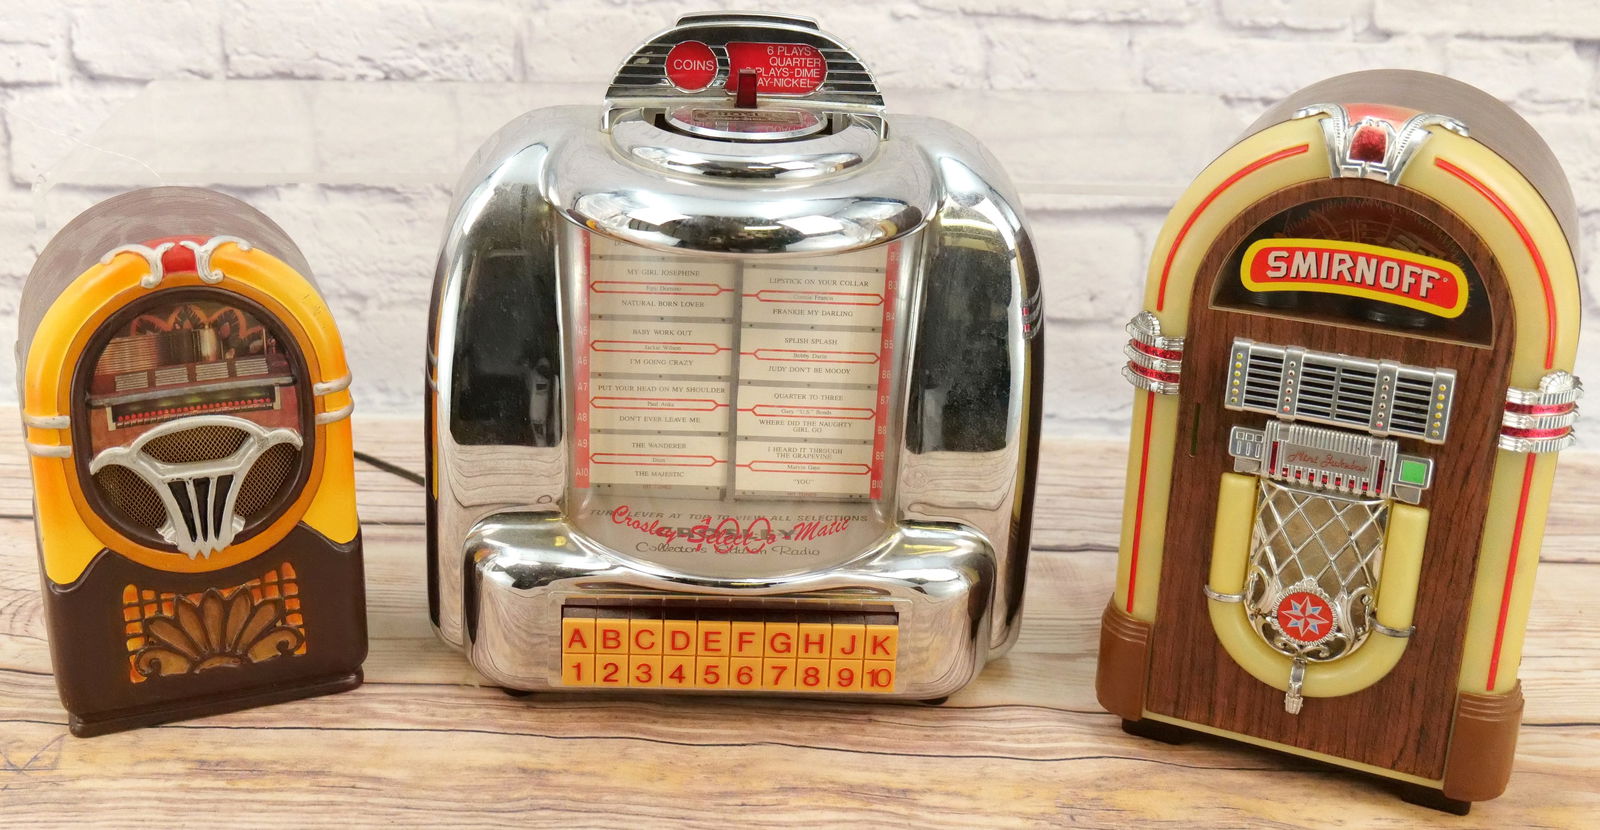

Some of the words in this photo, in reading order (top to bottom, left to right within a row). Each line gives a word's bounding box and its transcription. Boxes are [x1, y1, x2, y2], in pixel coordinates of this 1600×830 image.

[766, 46, 774, 57] 6
[673, 58, 714, 72] COINS
[769, 56, 821, 68] QUARTER
[756, 78, 814, 88] AY-NICKEL
[627, 268, 638, 276] MY
[661, 269, 700, 277] JOSEPHINE
[1266, 250, 1440, 298] SMIRNOFF
[804, 278, 816, 286] ON
[680, 300, 705, 308] LOVER
[772, 308, 805, 316] FRANKIE
[821, 310, 854, 318] DARLING
[784, 337, 809, 345] SPLISH
[810, 338, 838, 346] SPLASH
[577, 382, 588, 391] A7
[686, 386, 726, 394] SHOULDER
[774, 393, 808, 401] QUARTER
[577, 412, 588, 421] A8
[577, 439, 588, 448] A9
[773, 446, 798, 454] HEARD
[576, 468, 588, 477] A10
[628, 511, 665, 519] LEVER
[770, 514, 792, 522] ALL
[796, 515, 868, 523] SELECTIONS
[771, 545, 820, 556] Radio
[568, 628, 588, 649] A
[602, 629, 621, 649] B
[634, 628, 656, 650] C
[671, 630, 690, 651] D
[704, 631, 722, 652] E
[738, 632, 756, 653] F
[770, 632, 792, 654] G
[804, 633, 824, 654] H
[840, 634, 857, 655] J
[872, 635, 891, 656] K
[572, 662, 582, 682] 1
[602, 662, 619, 683] 2
[635, 663, 652, 683] 3
[668, 664, 686, 684] 4
[704, 665, 721, 685] 5
[737, 666, 754, 686] 6
[771, 666, 788, 686] 7
[802, 666, 821, 687] 8
[837, 668, 855, 688] 9
[866, 668, 892, 688] 10
